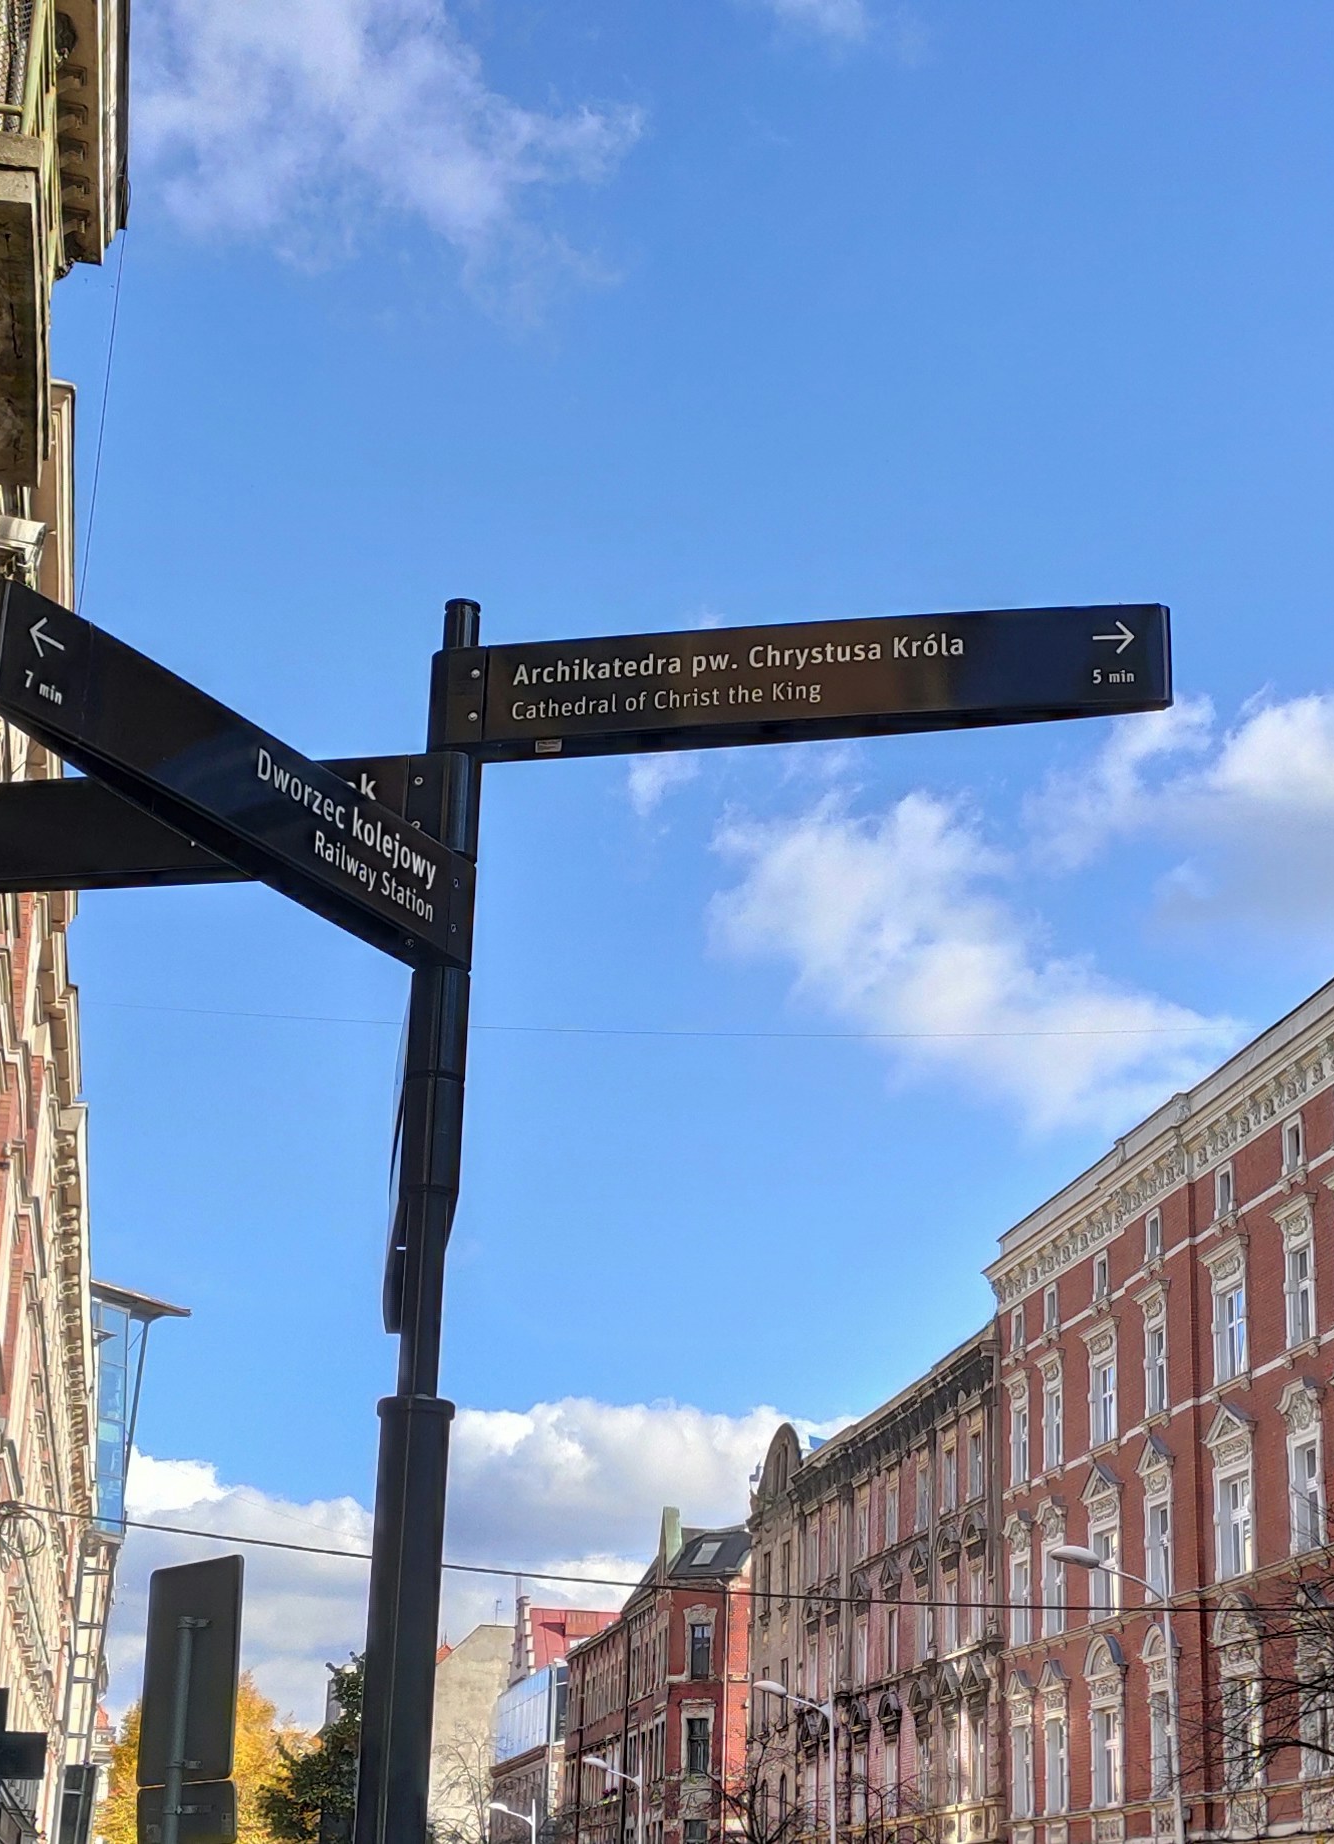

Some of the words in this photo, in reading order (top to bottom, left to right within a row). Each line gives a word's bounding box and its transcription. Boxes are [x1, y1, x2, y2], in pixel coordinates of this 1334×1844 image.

[512, 653, 682, 686] Archikatedra
[692, 653, 739, 677] pw.
[748, 642, 882, 670] Chrystusa
[893, 633, 965, 659] Króla
[1092, 669, 1102, 684] 5
[1109, 669, 1135, 683] min
[25, 669, 34, 688] 7
[39, 683, 63, 705] min
[511, 693, 617, 720] Cathedral
[625, 691, 648, 711] of
[654, 688, 720, 710] Christ
[728, 684, 764, 704] the
[772, 681, 822, 703] King
[257, 748, 346, 829] Dworzec
[352, 806, 437, 890] kolejowy
[314, 830, 377, 892] Railway
[380, 871, 434, 923] Station
